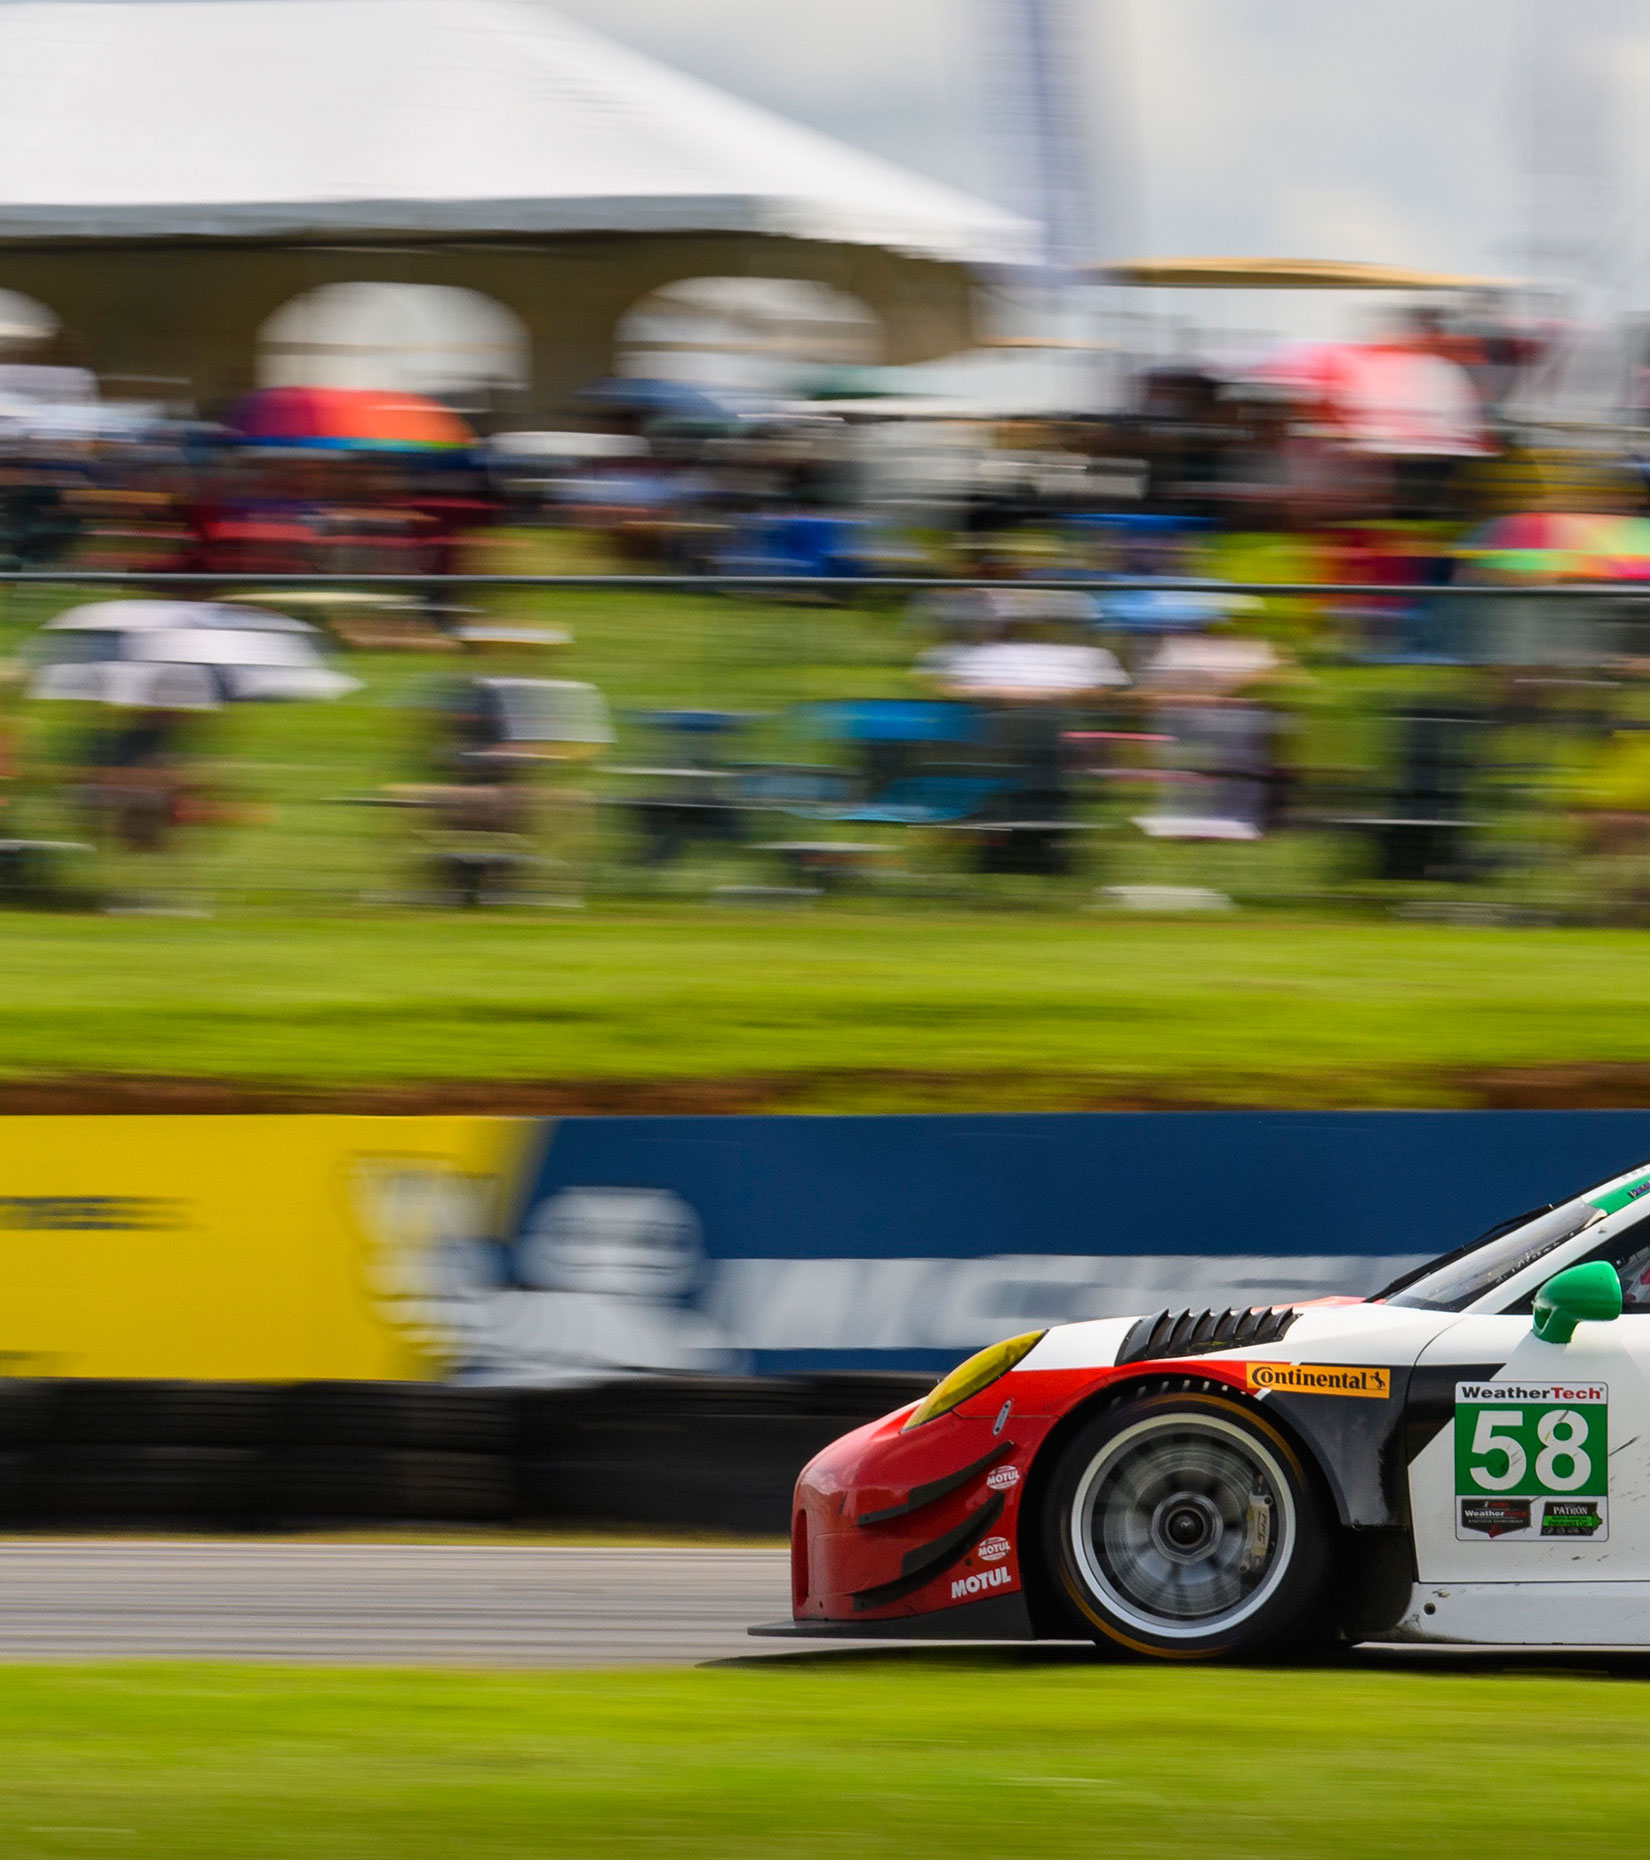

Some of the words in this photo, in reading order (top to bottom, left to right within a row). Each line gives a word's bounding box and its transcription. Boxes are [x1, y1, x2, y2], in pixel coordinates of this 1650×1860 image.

[1252, 1366, 1367, 1390] Continental
[1461, 1386, 1601, 1400] WeatherTech
[1469, 1409, 1592, 1492] 58
[987, 1470, 1020, 1486] MOTUL
[978, 1540, 1011, 1556] MOTUL
[951, 1566, 1012, 1599] MOTUL
